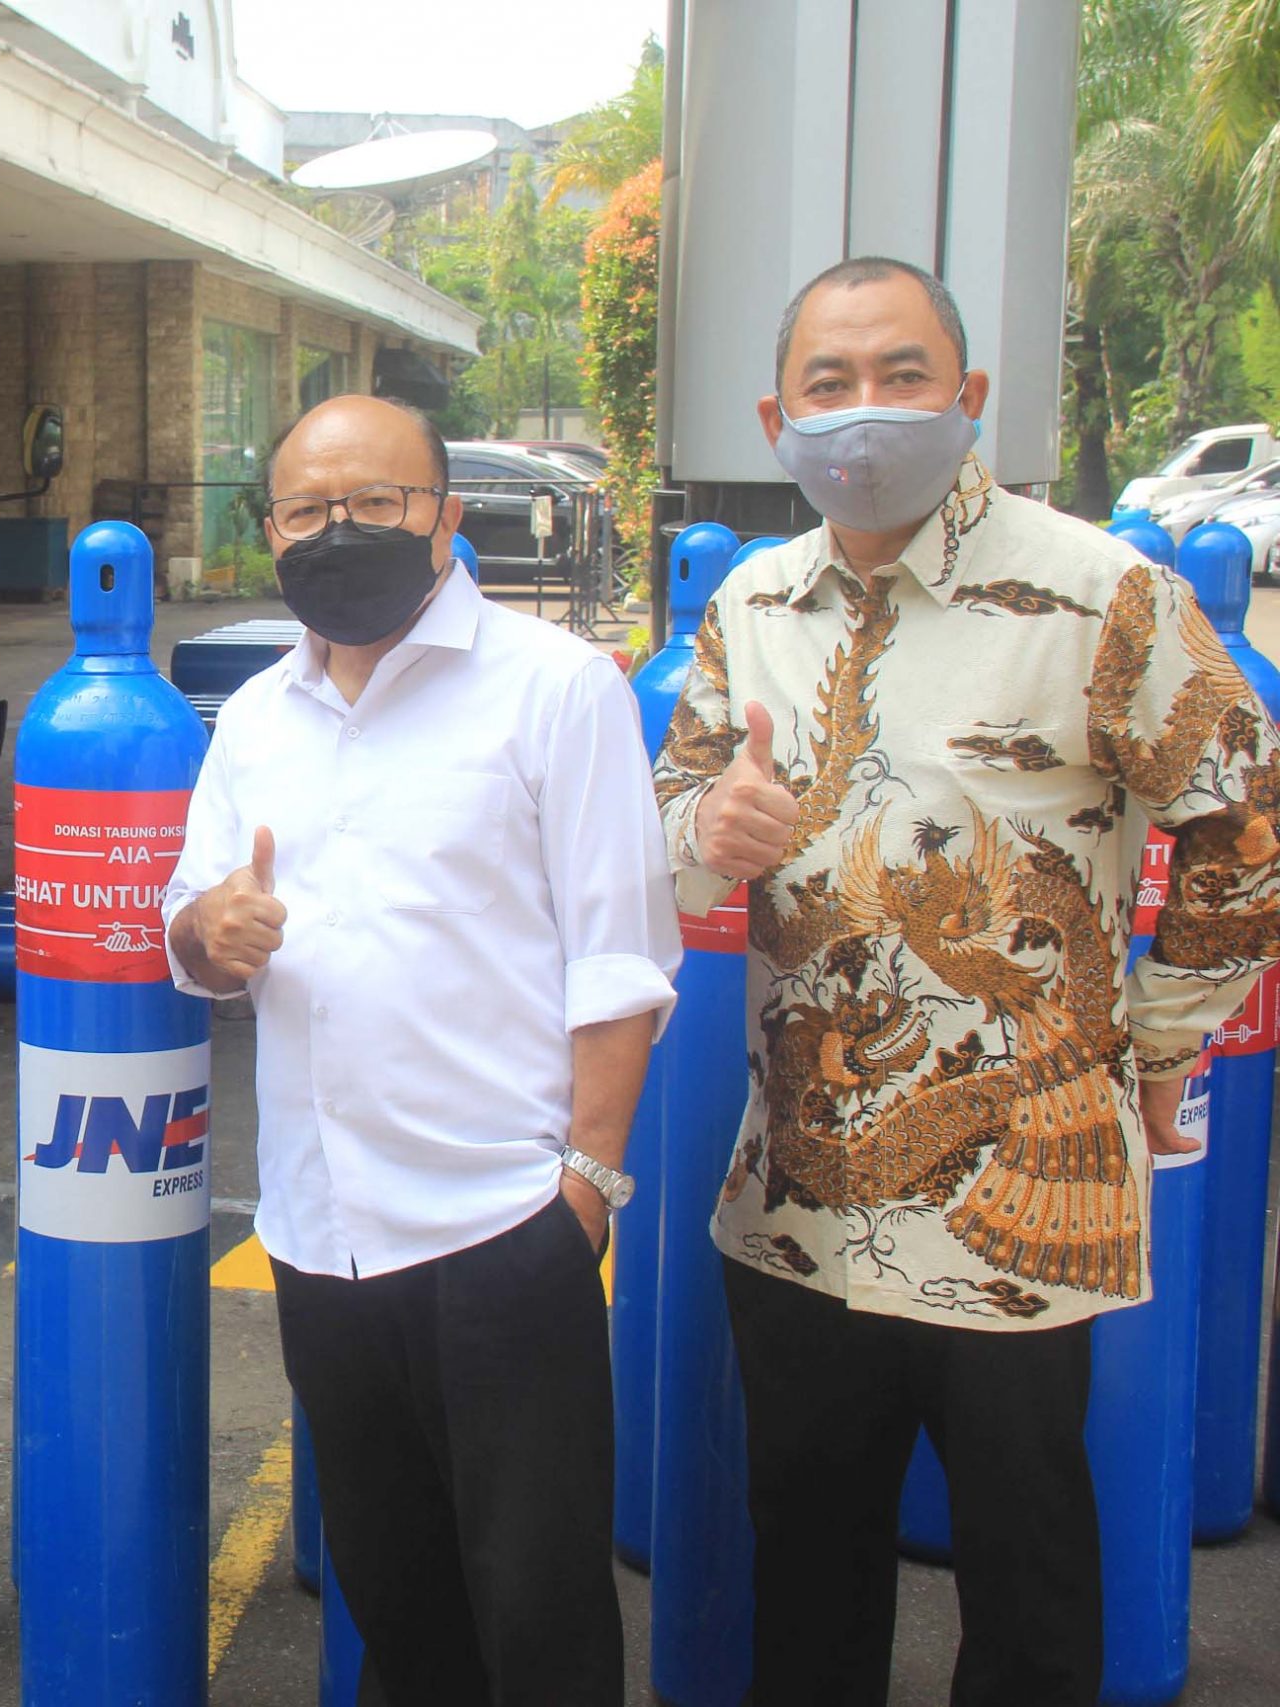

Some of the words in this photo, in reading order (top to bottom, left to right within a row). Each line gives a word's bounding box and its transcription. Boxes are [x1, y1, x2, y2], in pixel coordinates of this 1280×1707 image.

[54, 824, 101, 838] DONASI
[104, 827, 157, 839] TABUNG
[160, 826, 186, 838] OKSI
[106, 846, 151, 864] AIA
[73, 884, 169, 909] UNTUK
[1180, 1102, 1208, 1126] EXPRE
[24, 1084, 209, 1174] JNE
[152, 1171, 204, 1197] EXPRESS
